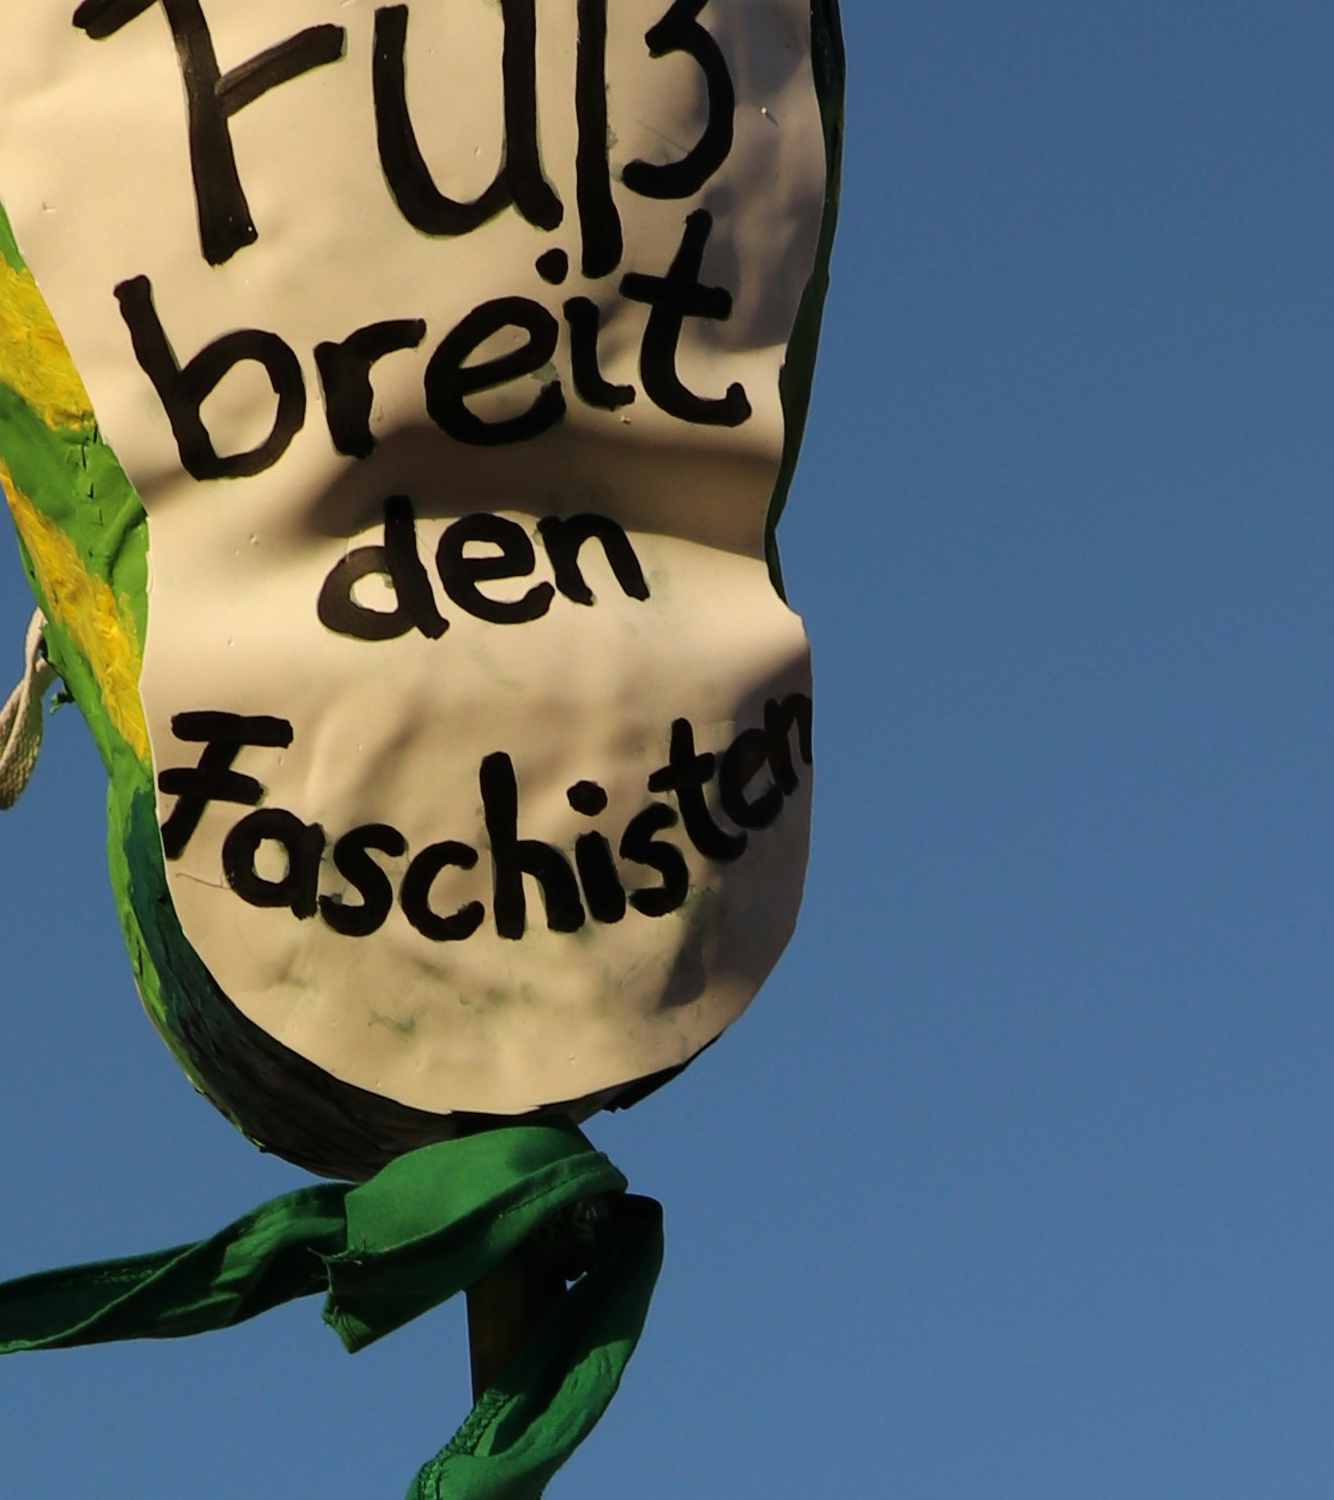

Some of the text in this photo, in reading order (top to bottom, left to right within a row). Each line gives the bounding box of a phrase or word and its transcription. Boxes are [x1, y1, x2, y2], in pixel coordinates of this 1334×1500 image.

[112, 208, 753, 482] breit
[315, 494, 651, 643] den
[157, 690, 814, 942] Faschisten
